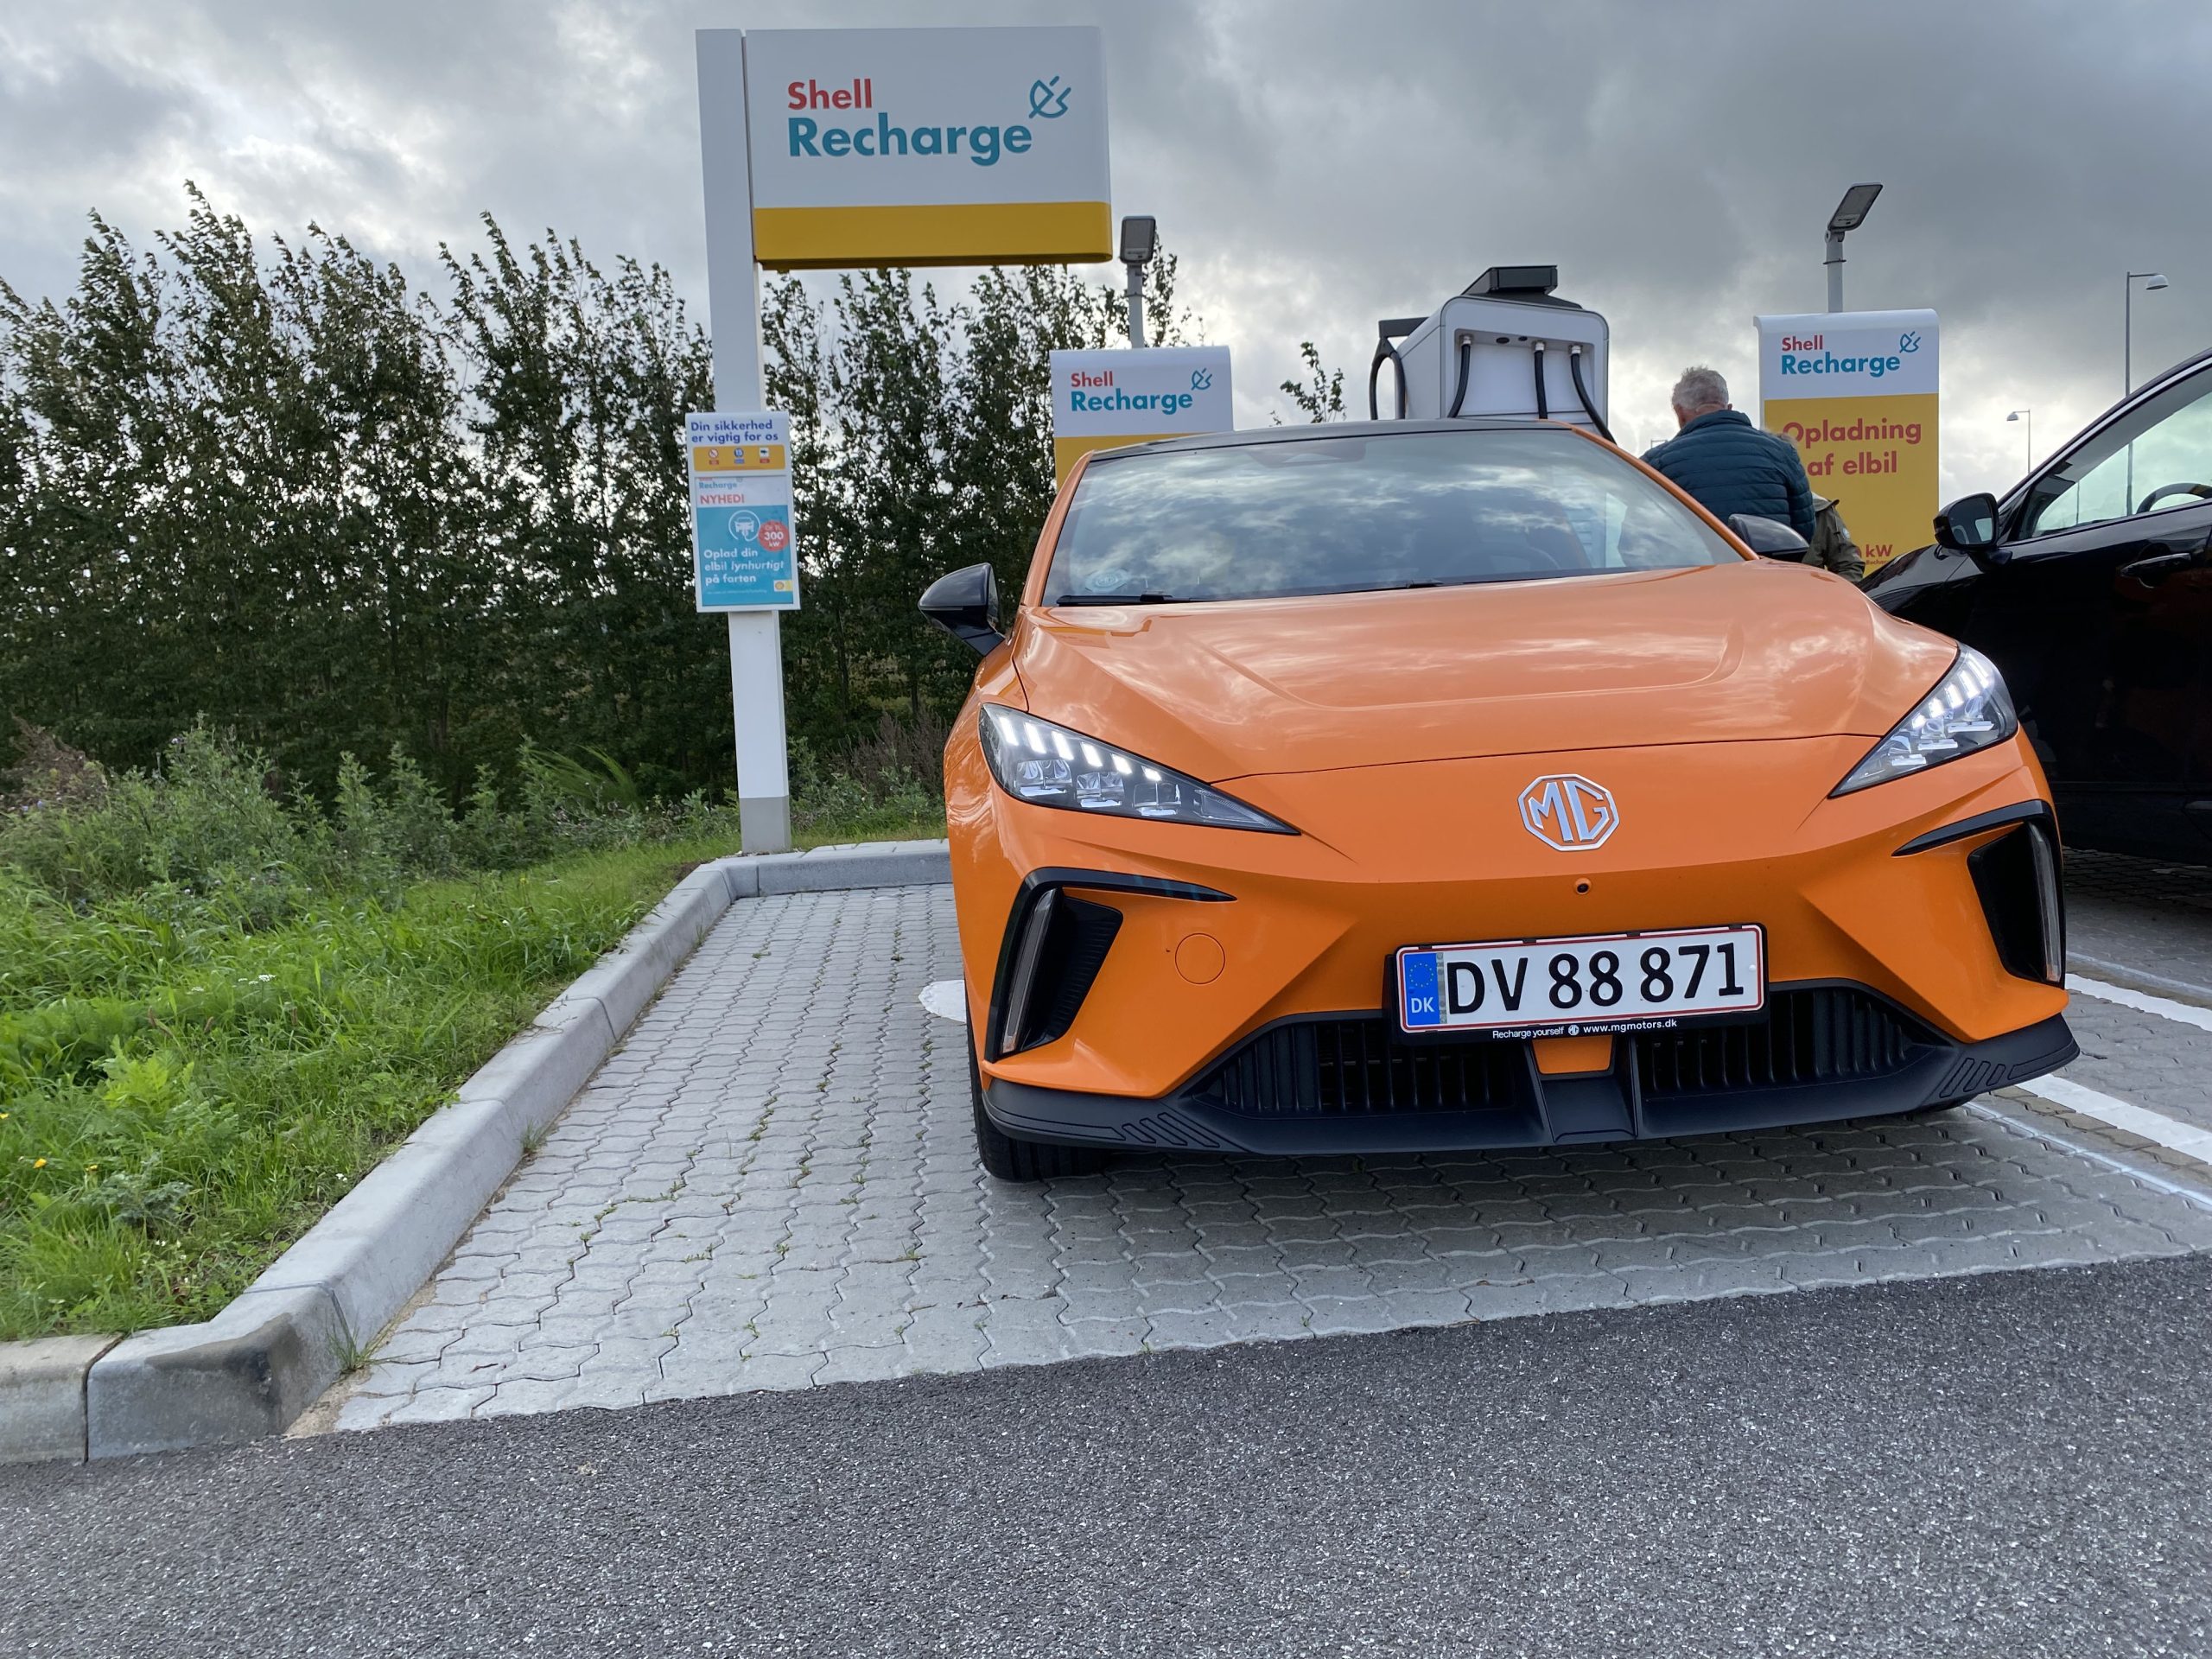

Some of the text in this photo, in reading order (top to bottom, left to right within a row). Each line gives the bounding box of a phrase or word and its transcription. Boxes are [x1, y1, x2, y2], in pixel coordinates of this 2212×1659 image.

[787, 78, 873, 110] Shell
[788, 112, 1033, 166] Recharge
[1782, 334, 1823, 352] Shell
[1781, 352, 1901, 378] Recharge
[1071, 371, 1113, 388] Shell
[1071, 388, 1193, 416] Recharge
[691, 419, 772, 431] Din sikkerhed
[1783, 418, 1922, 449] Opladning
[708, 433, 741, 444] vigtig
[745, 431, 761, 442] for
[1807, 451, 1898, 476] af elbil
[698, 481, 738, 490] Recharge
[764, 531, 784, 540] 300
[703, 548, 759, 560] Oplad din
[1866, 544, 1893, 557] kW
[704, 560, 785, 572] elbil lynhurtigt
[705, 574, 757, 586] på farten
[1528, 780, 1610, 843] MG
[1446, 942, 1744, 1014] DV 88 871
[1411, 997, 1435, 1014] DK
[1492, 1029, 1531, 1039] Recharge
[1533, 1027, 1565, 1038] yourself
[1583, 1019, 1677, 1033] www.mgmotors.dk
